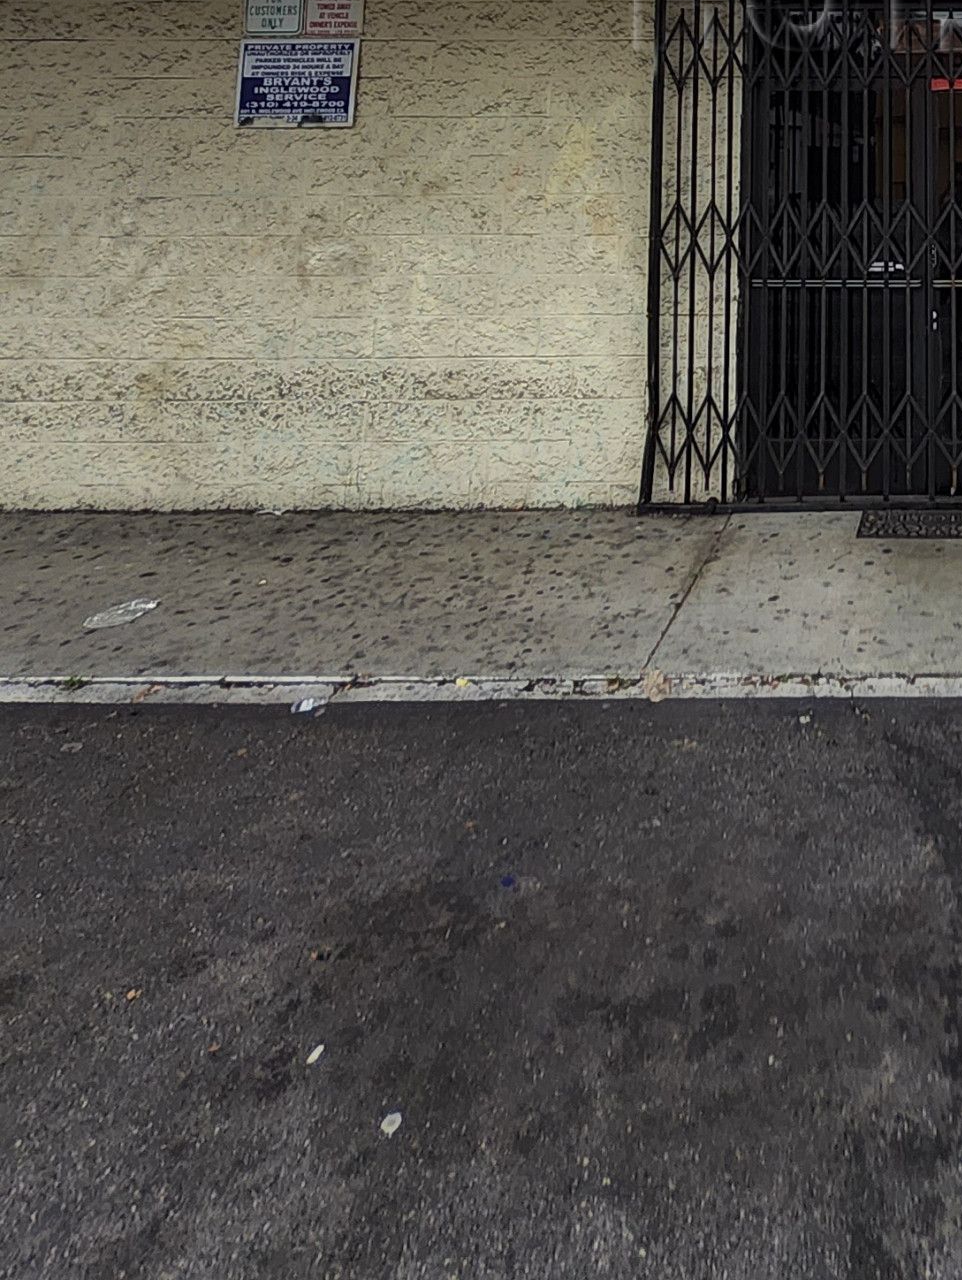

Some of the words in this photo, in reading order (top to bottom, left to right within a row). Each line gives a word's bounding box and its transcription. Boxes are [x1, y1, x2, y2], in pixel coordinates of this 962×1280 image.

[249, 5, 297, 16] CUSTOMERS
[261, 17, 284, 29] ONLY
[263, 77, 332, 86] BRYANT'S
[254, 86, 340, 94] INGLEWOOD
